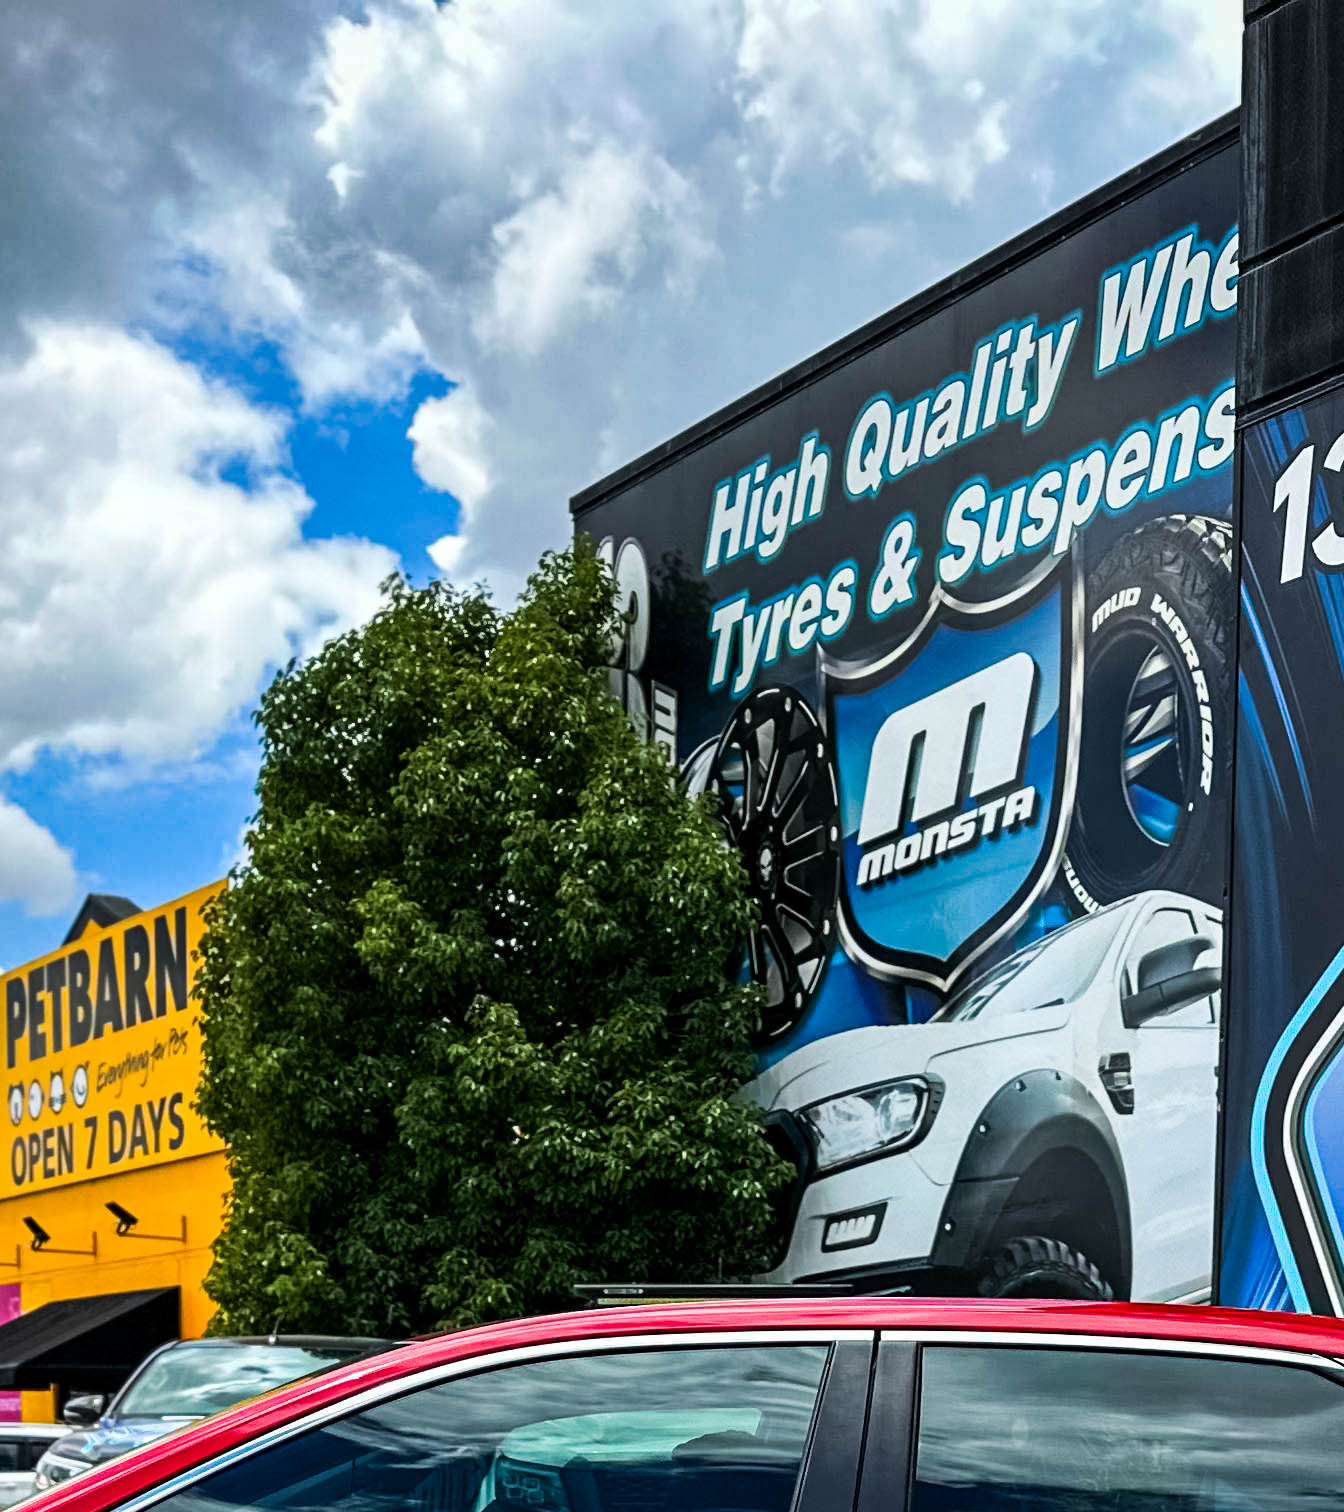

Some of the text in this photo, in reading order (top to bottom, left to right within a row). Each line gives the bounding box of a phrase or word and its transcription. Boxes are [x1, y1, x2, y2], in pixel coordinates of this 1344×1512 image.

[705, 437, 830, 570] High
[845, 318, 1080, 493] Quality
[709, 567, 856, 693] Tyres
[871, 518, 919, 615] &
[1091, 587, 1214, 796] MUD WARRIOR
[857, 786, 1036, 886] MONSTA
[6, 906, 188, 1069] PETBARN
[11, 1091, 185, 1187] OPEN 7 DAYS
[96, 1050, 150, 1099] Everything
